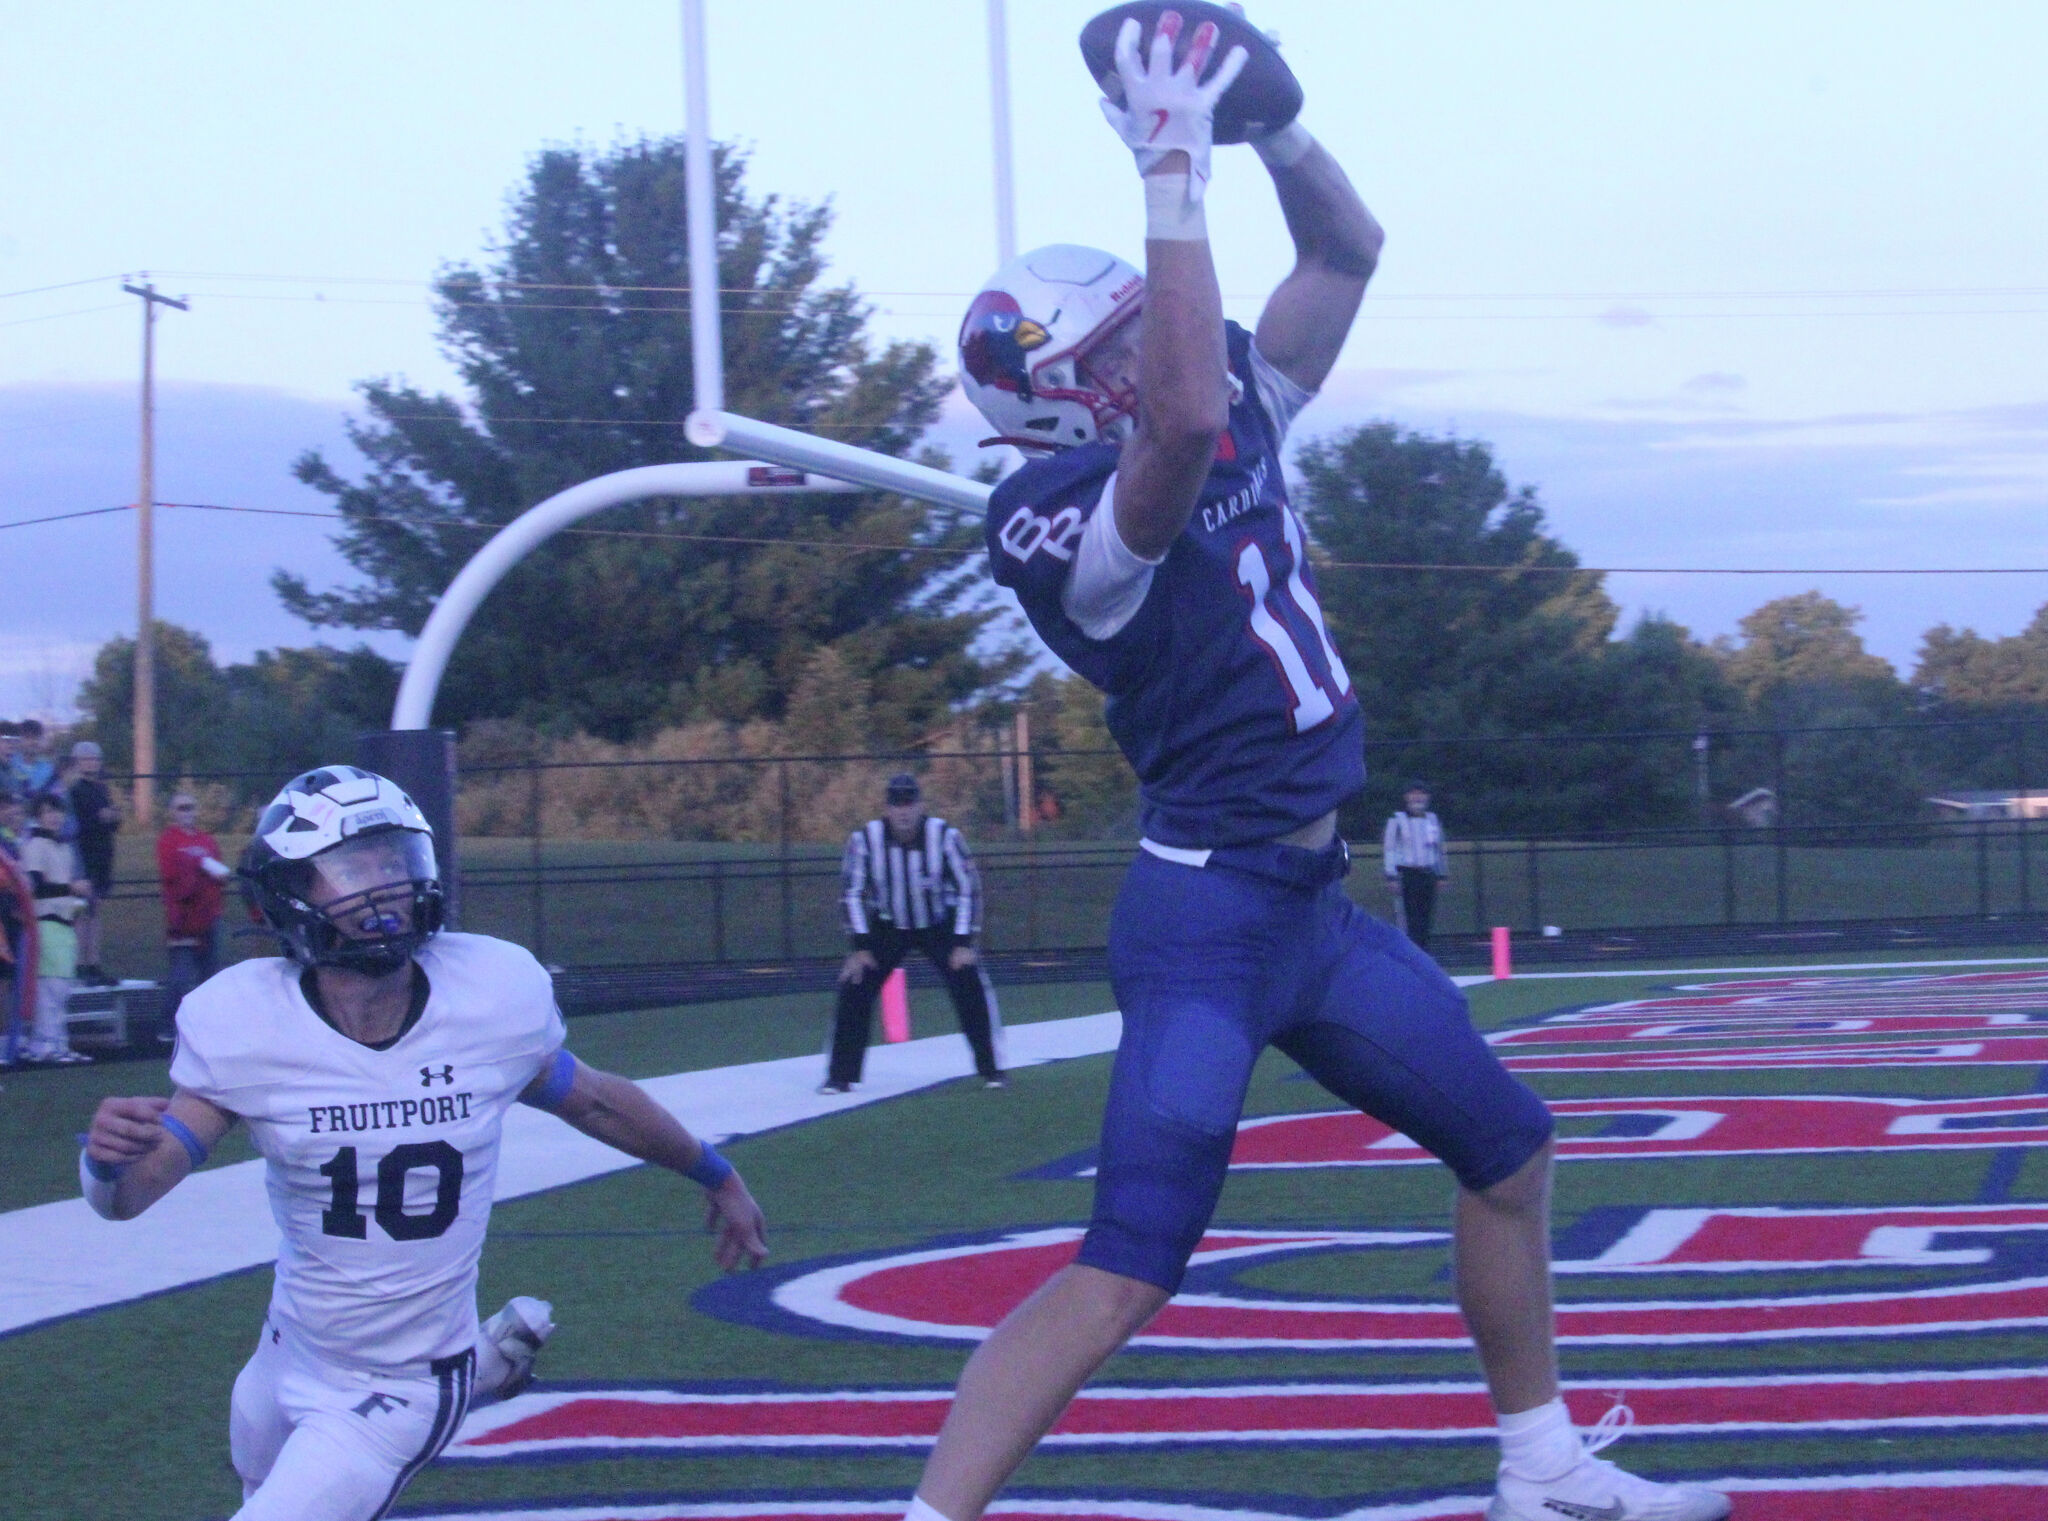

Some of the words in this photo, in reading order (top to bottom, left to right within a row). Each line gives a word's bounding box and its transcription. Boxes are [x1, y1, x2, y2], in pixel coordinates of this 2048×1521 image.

[1237, 504, 1350, 733] 11
[308, 1092, 472, 1133] FRUITPORT
[319, 1139, 464, 1241] 10
